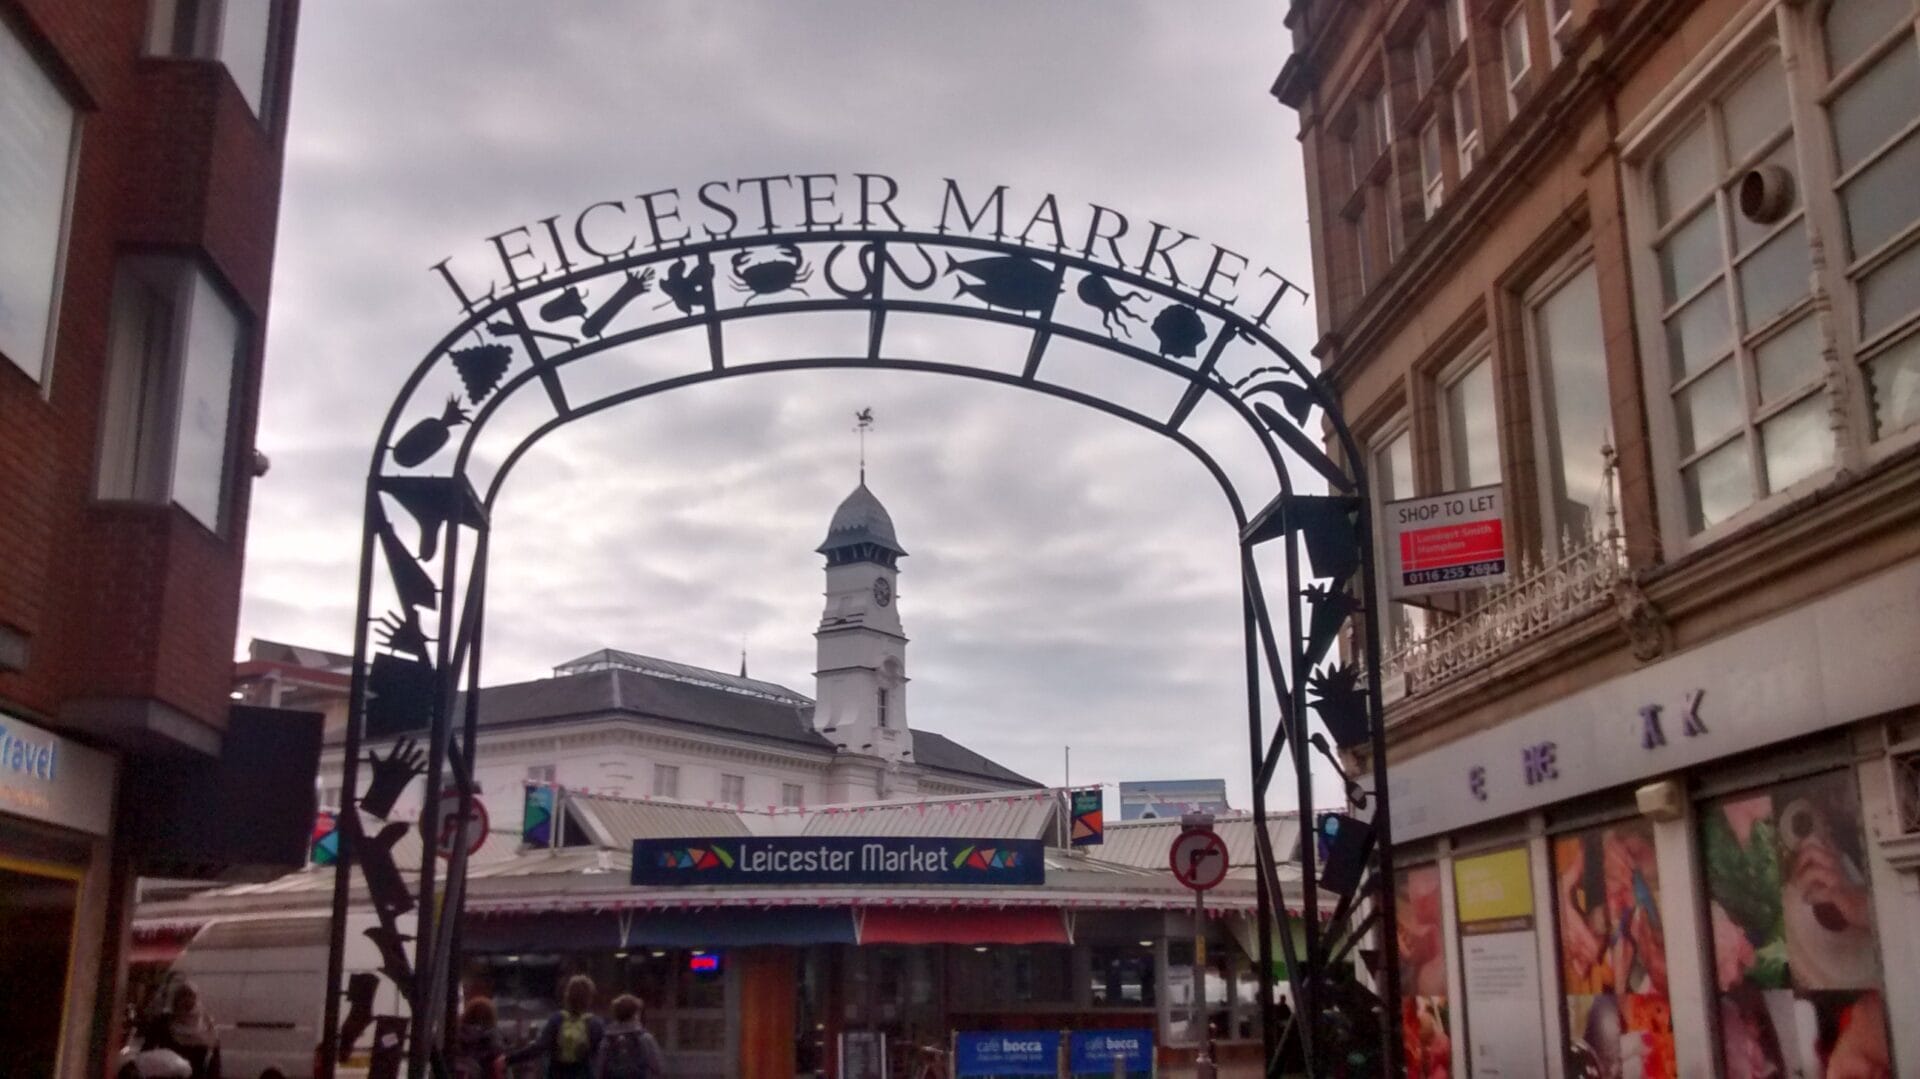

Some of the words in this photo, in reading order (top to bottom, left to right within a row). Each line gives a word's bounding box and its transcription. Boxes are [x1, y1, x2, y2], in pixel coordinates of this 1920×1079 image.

[429, 174, 906, 315] LEICESTER
[937, 177, 1310, 329] MARKET
[1399, 503, 1439, 524] SHOP
[1444, 500, 1464, 517] TO
[1470, 495, 1495, 513] LET
[1410, 571, 1439, 583] 0116
[1442, 566, 1465, 580] 255
[740, 844, 854, 872] Leicester
[861, 844, 949, 872] Market
[1003, 1039, 1042, 1053] bocca
[1106, 1037, 1139, 1050] bocca
